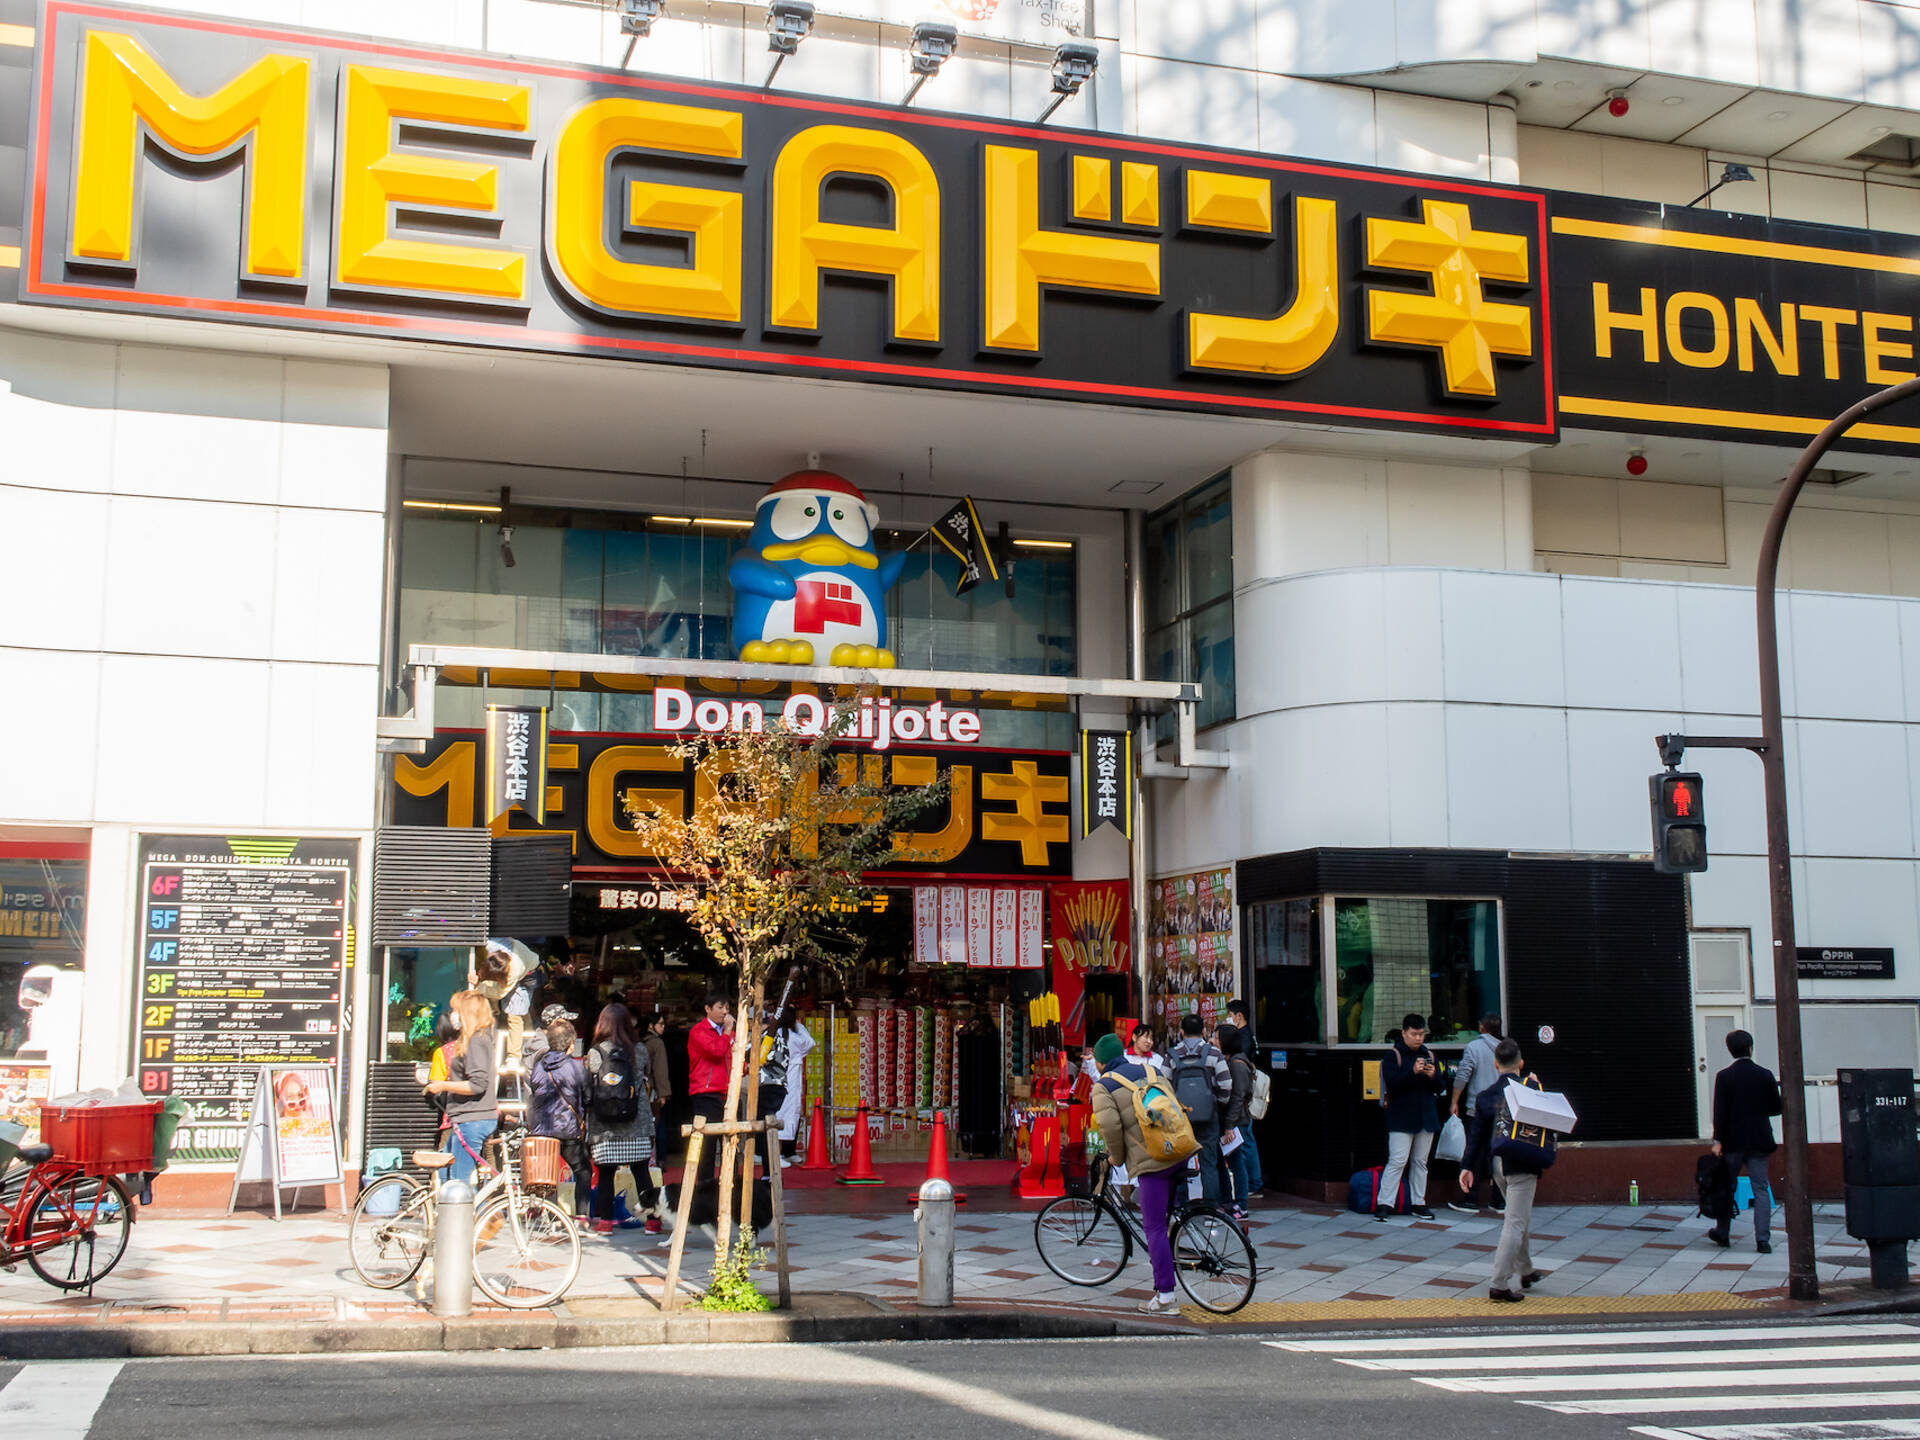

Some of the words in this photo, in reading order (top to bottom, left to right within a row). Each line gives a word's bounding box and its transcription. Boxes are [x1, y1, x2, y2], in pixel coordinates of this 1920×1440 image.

[794, 580, 862, 634] ド
[653, 687, 764, 734] Don
[782, 693, 982, 750] Quijote
[504, 713, 529, 801] 渋谷本店
[1096, 736, 1117, 818] 渋谷本店
[148, 853, 177, 862] MEGA
[259, 857, 302, 865] SHIBUYA
[310, 857, 349, 866] HONTEN
[151, 875, 181, 896] 6F
[151, 909, 179, 929] 5F
[149, 941, 178, 962] 4F
[1831, 951, 1854, 960] PPIH
[147, 973, 176, 994] 3F
[144, 1005, 174, 1027] 2F
[144, 1038, 172, 1059] 1F
[143, 1071, 169, 1092] B1
[1875, 1096, 1908, 1106] 331-117
